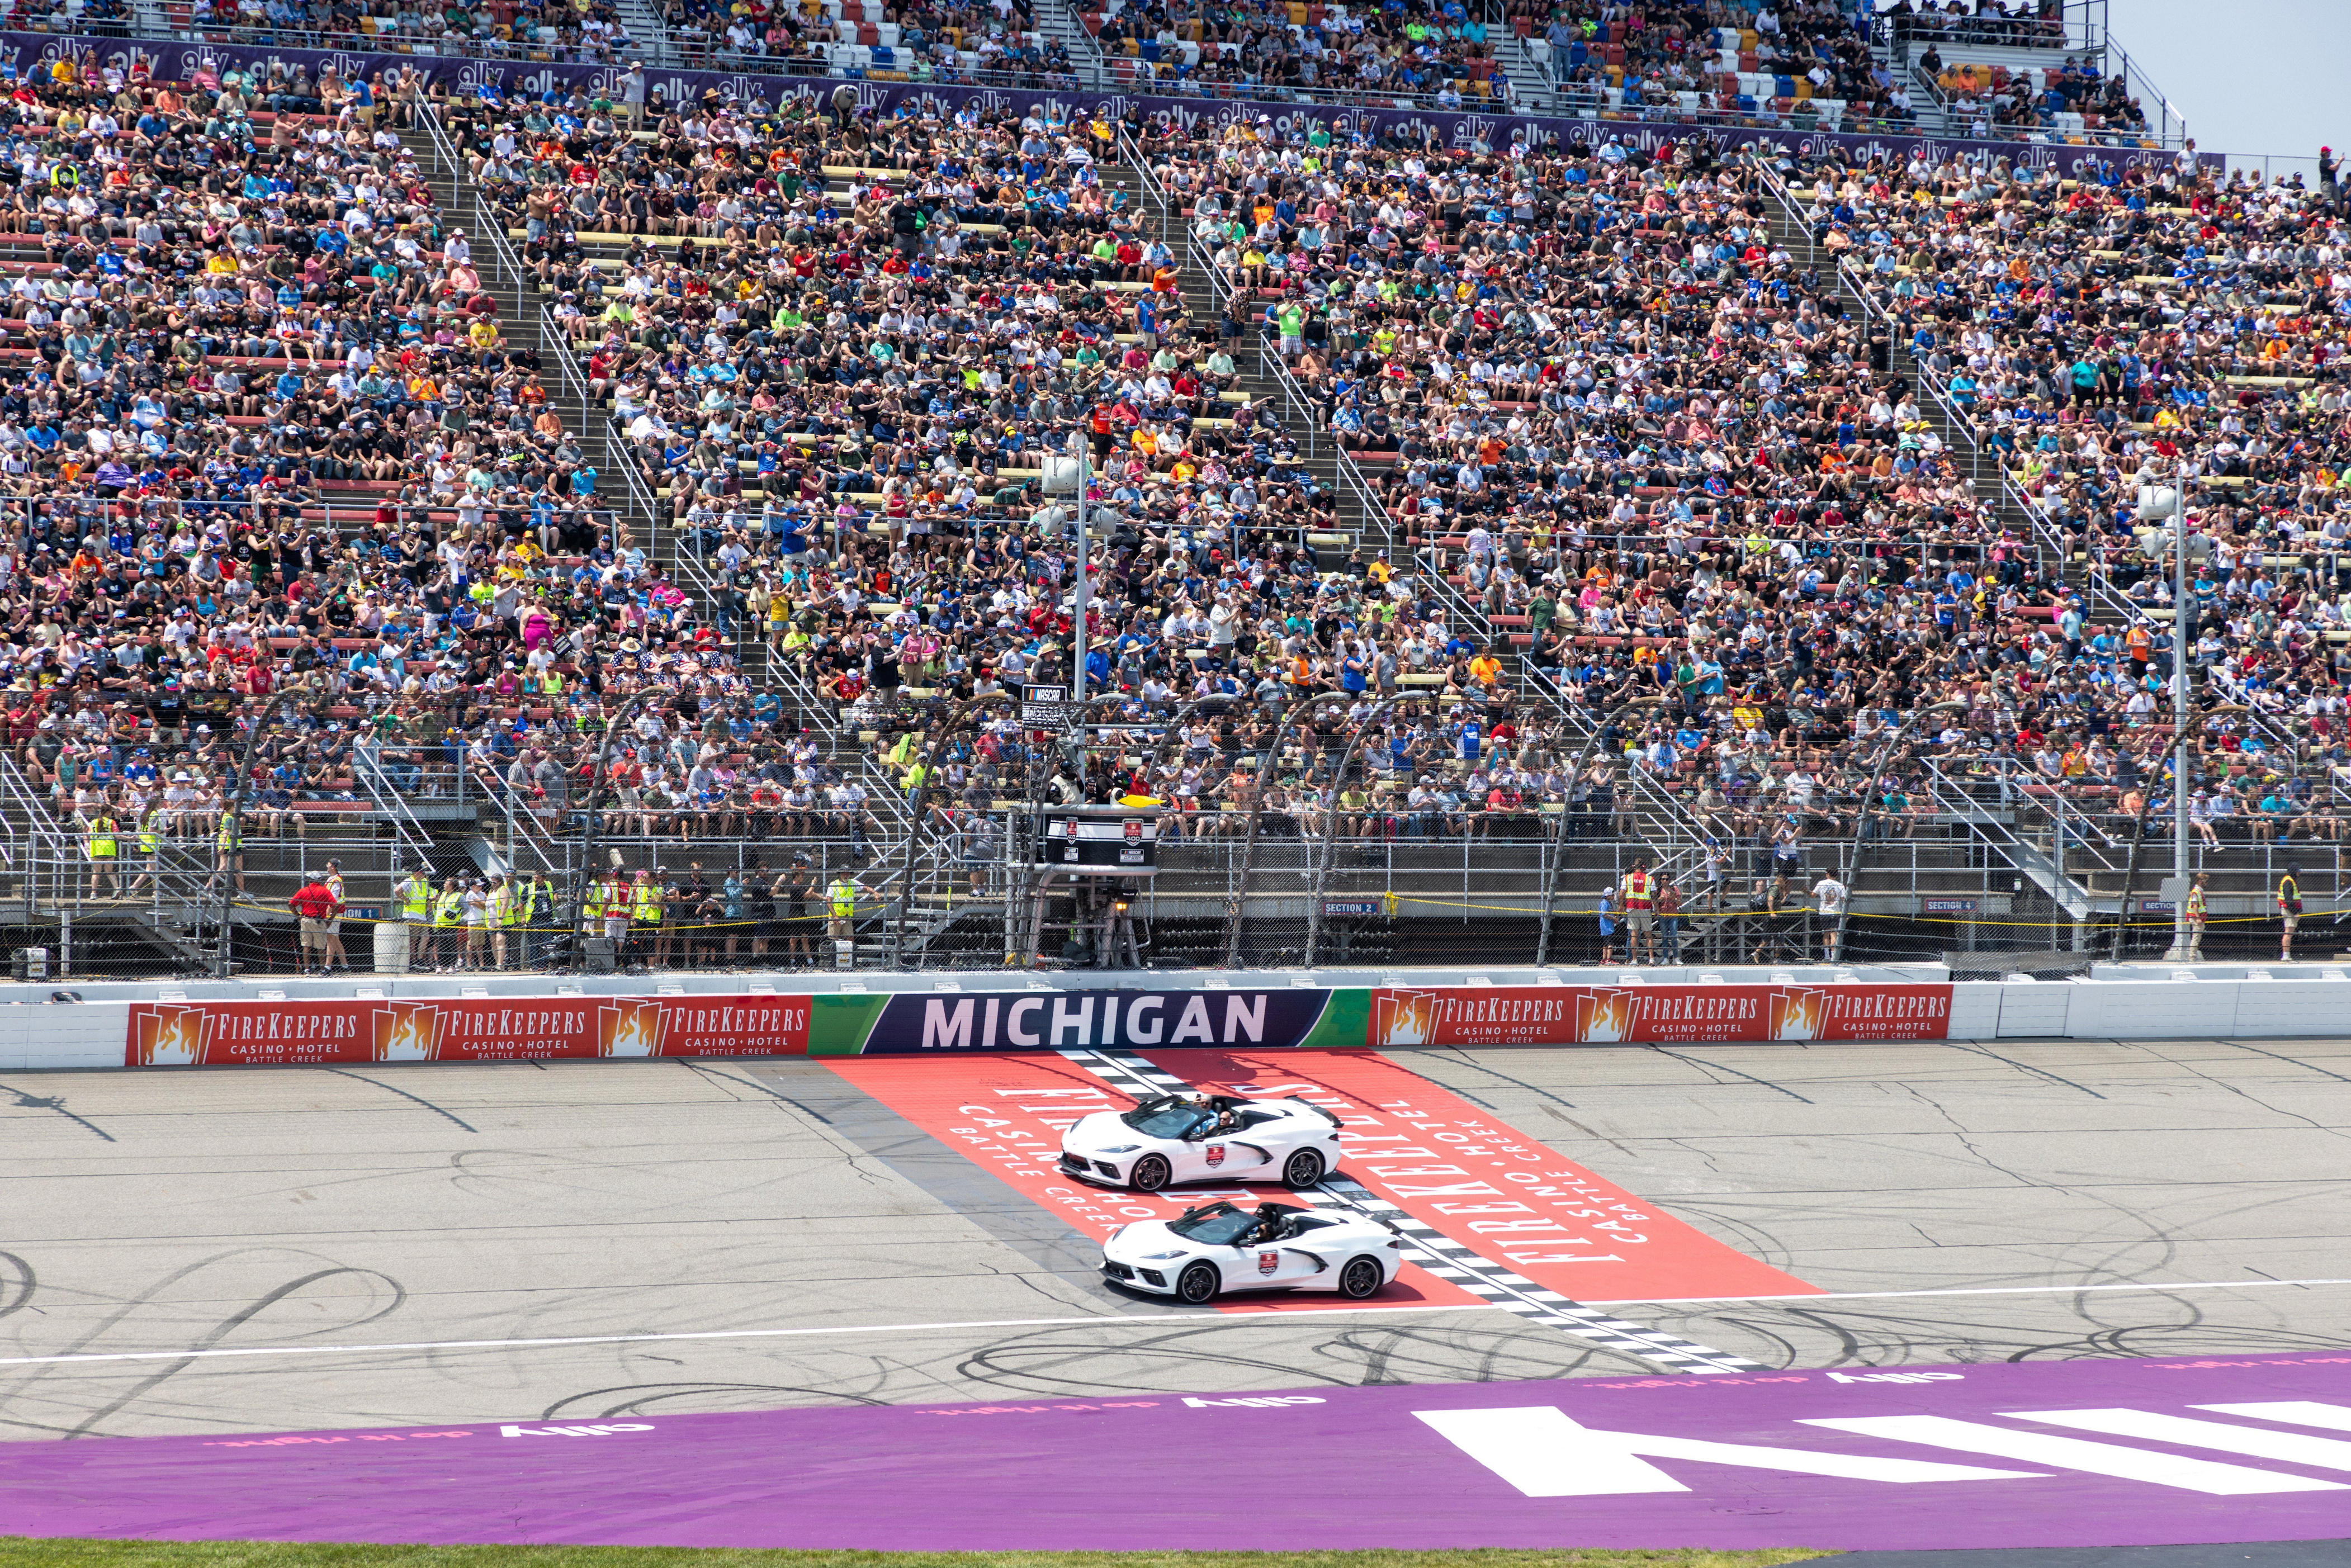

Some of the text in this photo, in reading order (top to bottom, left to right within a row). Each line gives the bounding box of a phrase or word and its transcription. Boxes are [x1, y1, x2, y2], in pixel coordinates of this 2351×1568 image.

[113, 47, 159, 73] aly
[384, 63, 431, 85] aly
[588, 68, 623, 92] all
[717, 76, 762, 104] ally
[1454, 116, 1495, 141] ally
[1569, 122, 1609, 148] ally
[1036, 689, 1061, 701] NASCAR
[1326, 904, 1371, 912] SECTION 2
[1445, 998, 1563, 1022] FIREKEEPERS
[1642, 996, 1757, 1020] FIREKEEPERS
[1834, 994, 1946, 1018] FIREKEEPERS
[217, 1012, 357, 1040] FIREKEEPERS
[450, 1010, 585, 1036] FIREKEEPERS
[673, 1007, 804, 1032] FIREKEEPERS
[921, 995, 1267, 1048] MICHIGAN
[1455, 1026, 1548, 1035] CASINO HOTEL
[1652, 1025, 1696, 1033] CASINO
[230, 1044, 340, 1054] CASINO HOTEL
[463, 1040, 569, 1050] CASINO HOTEL
[685, 1037, 788, 1046] CASINO HOTEL
[958, 1105, 1071, 1174] CASIN
[949, 1128, 1046, 1177] BATTLE
[1045, 1187, 1124, 1231] CREEK
[1380, 1099, 1649, 1243] CASINO HOTEL
[1454, 1120, 1650, 1221] BATTLE CREEK
[1825, 1371, 1965, 1384] ally
[1181, 1395, 1326, 1408] ally
[501, 1423, 655, 1437] ally
